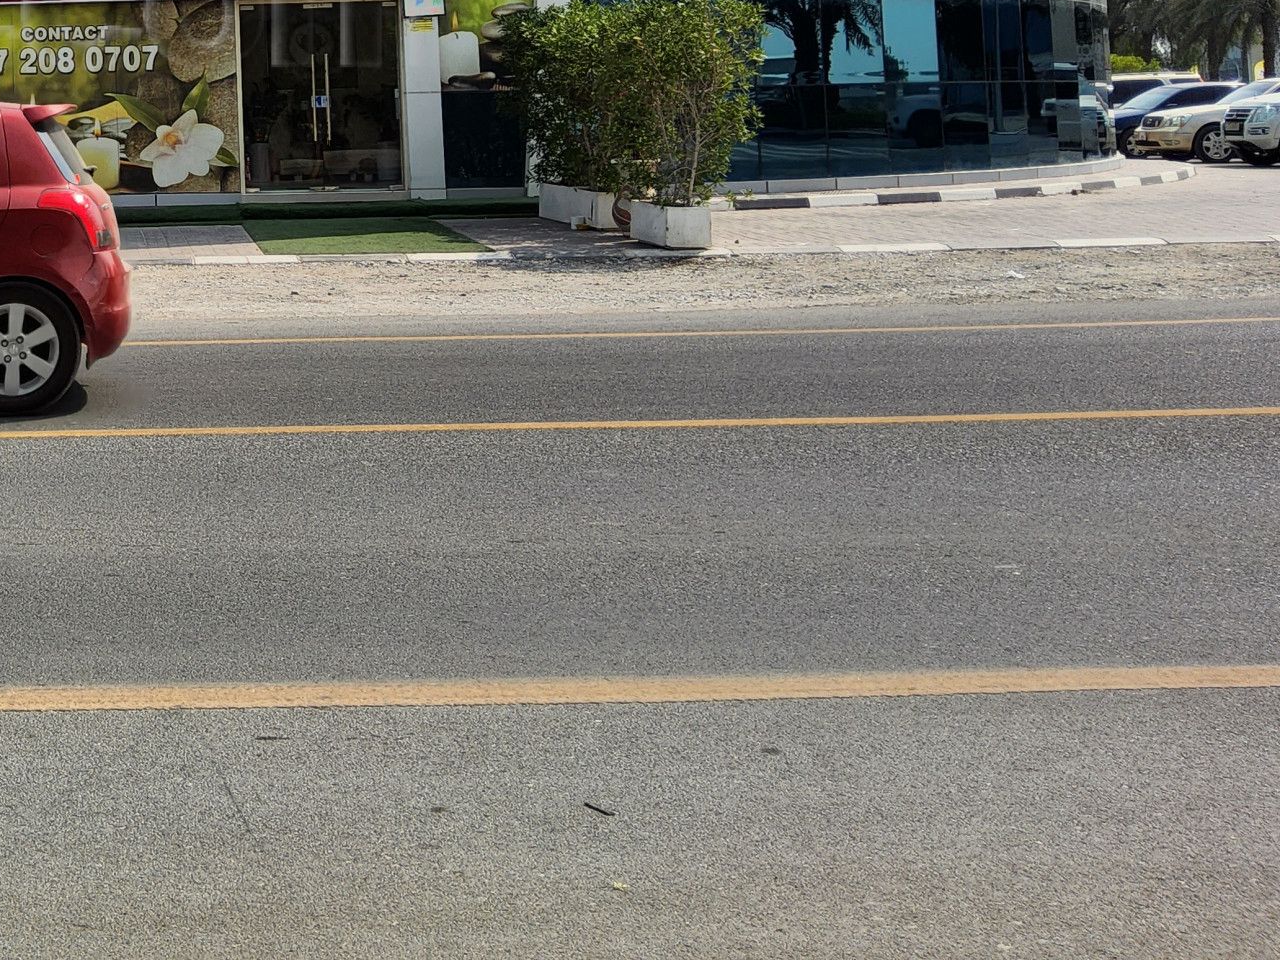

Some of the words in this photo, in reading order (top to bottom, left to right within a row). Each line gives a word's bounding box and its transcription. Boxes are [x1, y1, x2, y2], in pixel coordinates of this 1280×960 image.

[20, 25, 109, 42] CONTACT
[19, 46, 76, 75] 208
[84, 44, 160, 73] 0707
